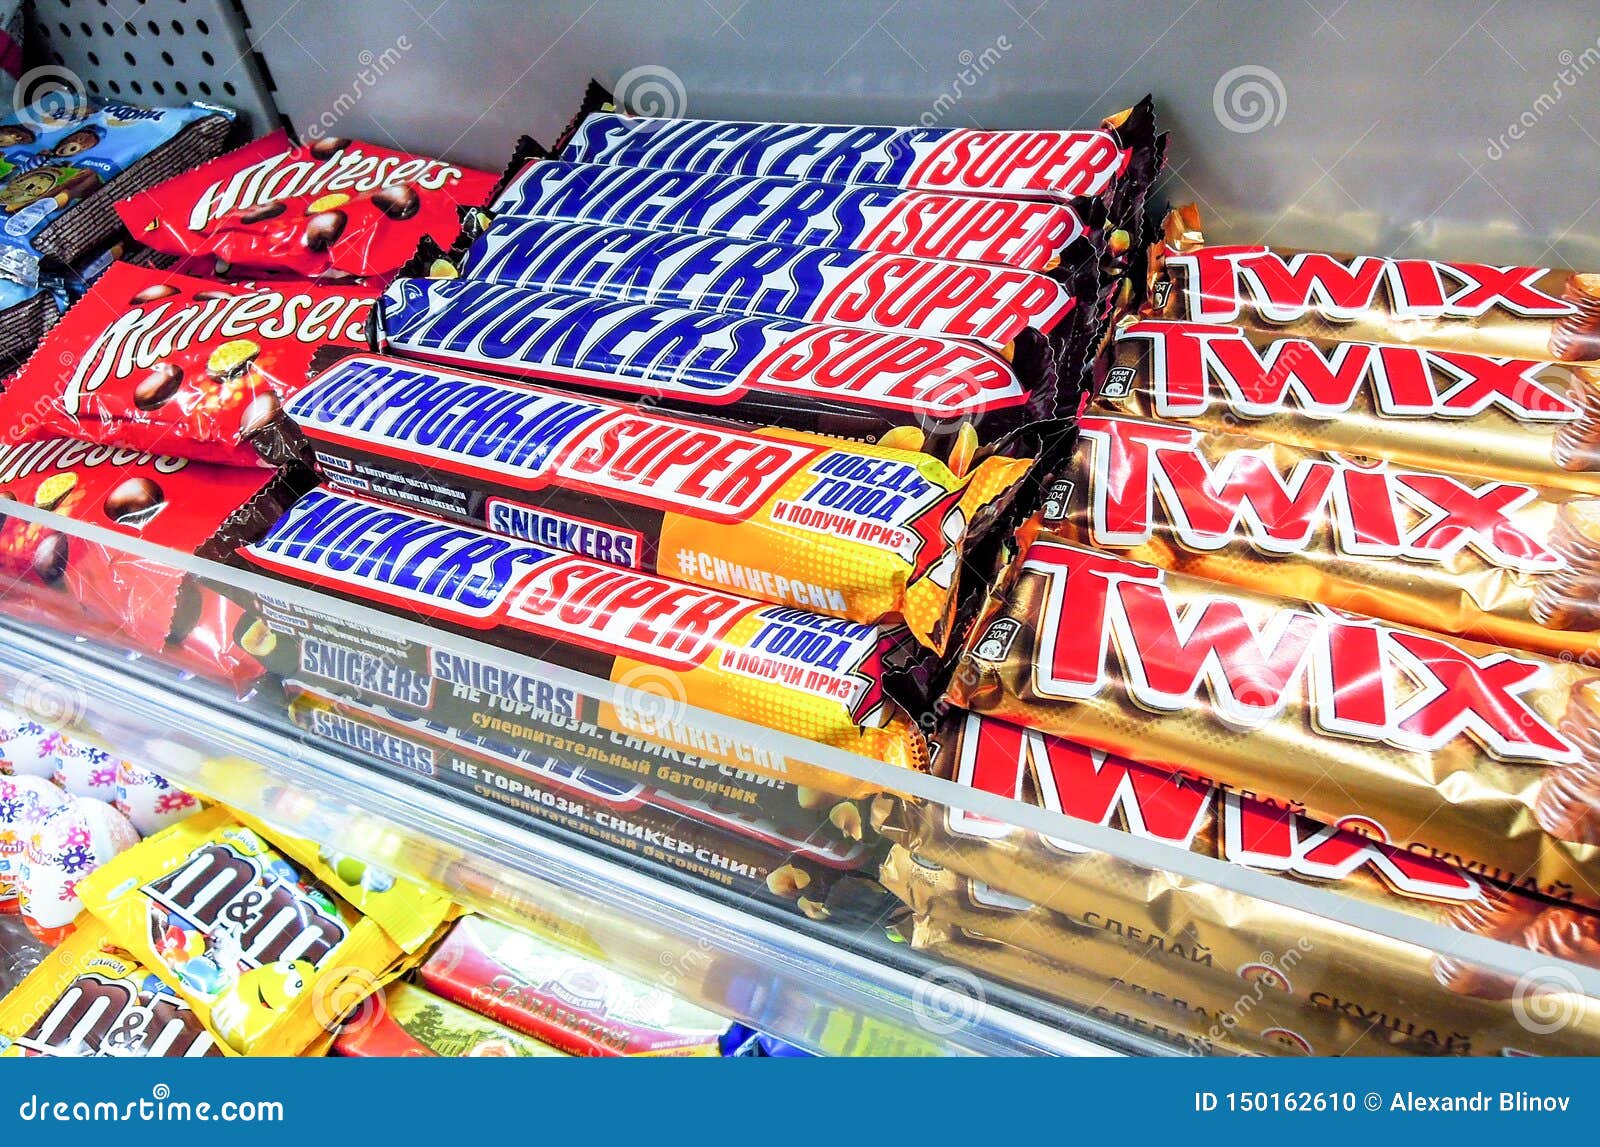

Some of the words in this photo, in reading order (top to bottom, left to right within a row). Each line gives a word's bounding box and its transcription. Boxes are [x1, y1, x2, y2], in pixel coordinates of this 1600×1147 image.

[560, 115, 953, 186] SNICKERS
[925, 130, 1119, 196] SUPER
[189, 149, 463, 231] Maltesers
[499, 162, 906, 249] SNICKERS
[881, 192, 1075, 272] SUPER
[832, 258, 1059, 344] SUPER
[62, 289, 374, 415] Maltesers
[767, 328, 1012, 405] SUPER
[569, 419, 784, 511] SUPER
[813, 453, 931, 499] ПОБЕДИ
[774, 501, 787, 518] И
[788, 506, 855, 537] ПОЛУЧИ
[803, 477, 896, 524] ГОЛОД
[491, 506, 633, 568] SNICKERS
[520, 563, 724, 656] SUPER
[677, 549, 848, 611] #СНИКЕРСНИ
[751, 626, 852, 671] ГОЛОД
[988, 630, 1008, 640] 204
[304, 640, 430, 707] SNICKERS
[434, 649, 577, 719] SNICKERS
[723, 652, 734, 668] И
[738, 655, 803, 687] ПОЛУЧИ
[316, 713, 434, 775] SNICKERS
[656, 764, 759, 804] батончик
[452, 759, 479, 778] НЕ
[595, 812, 758, 880] СНИКЕРСНИ!
[1083, 911, 1213, 968] СДЕЛАЙ
